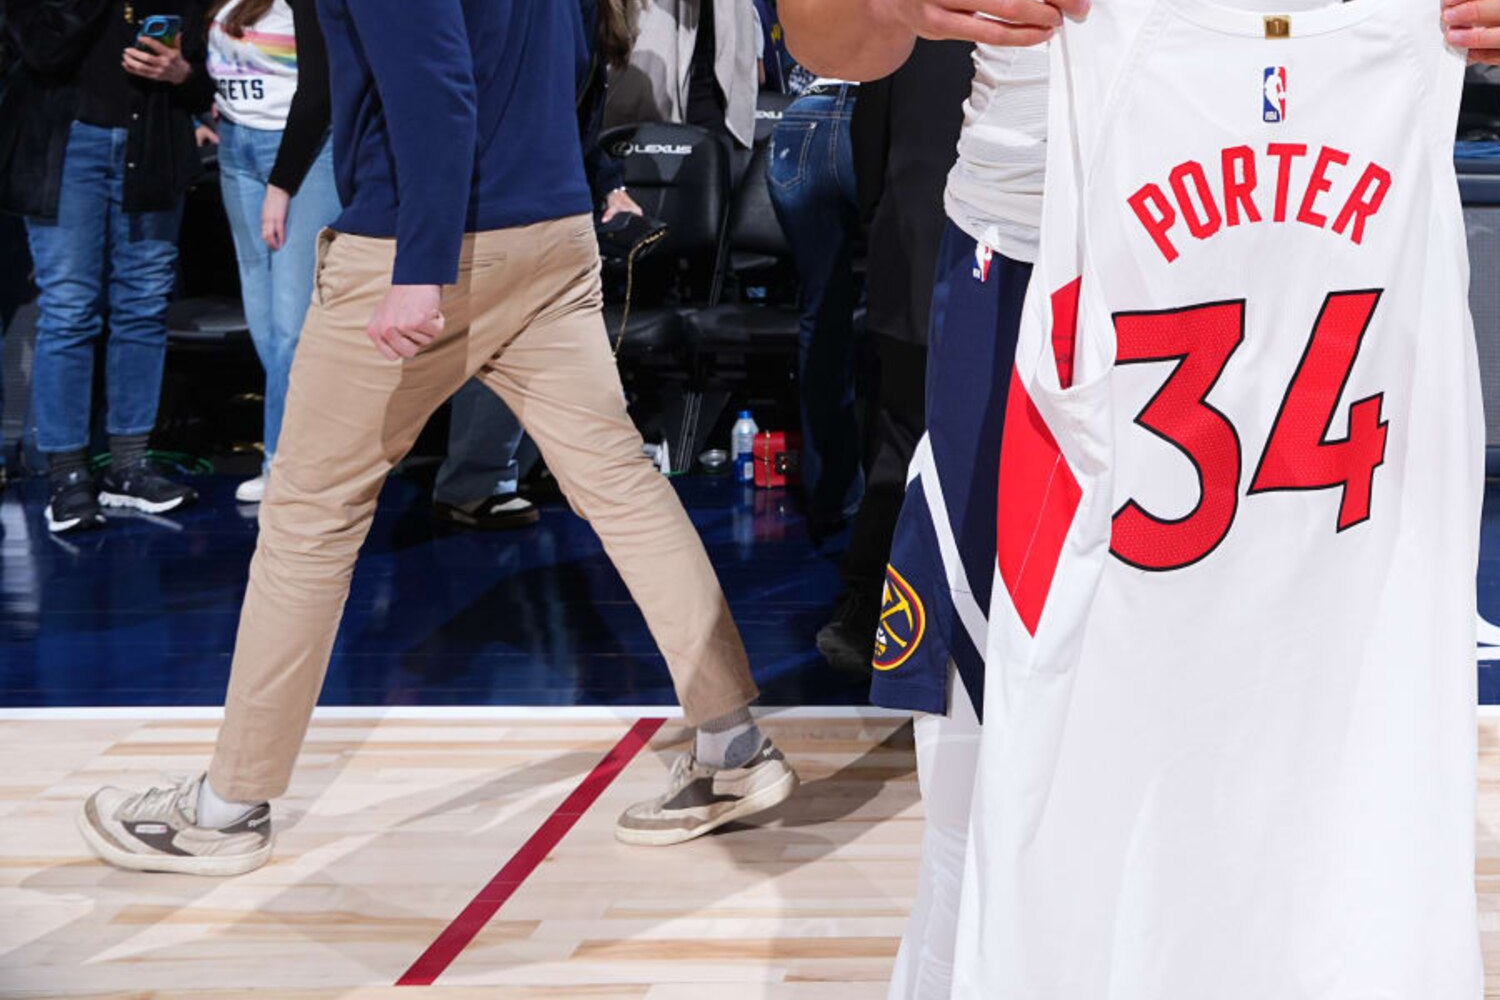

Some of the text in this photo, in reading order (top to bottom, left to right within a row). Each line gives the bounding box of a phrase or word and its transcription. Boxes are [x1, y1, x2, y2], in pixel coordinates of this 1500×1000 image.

[634, 144, 692, 154] LEXUS
[1127, 143, 1392, 263] PORTER
[1109, 288, 1389, 572] 34
